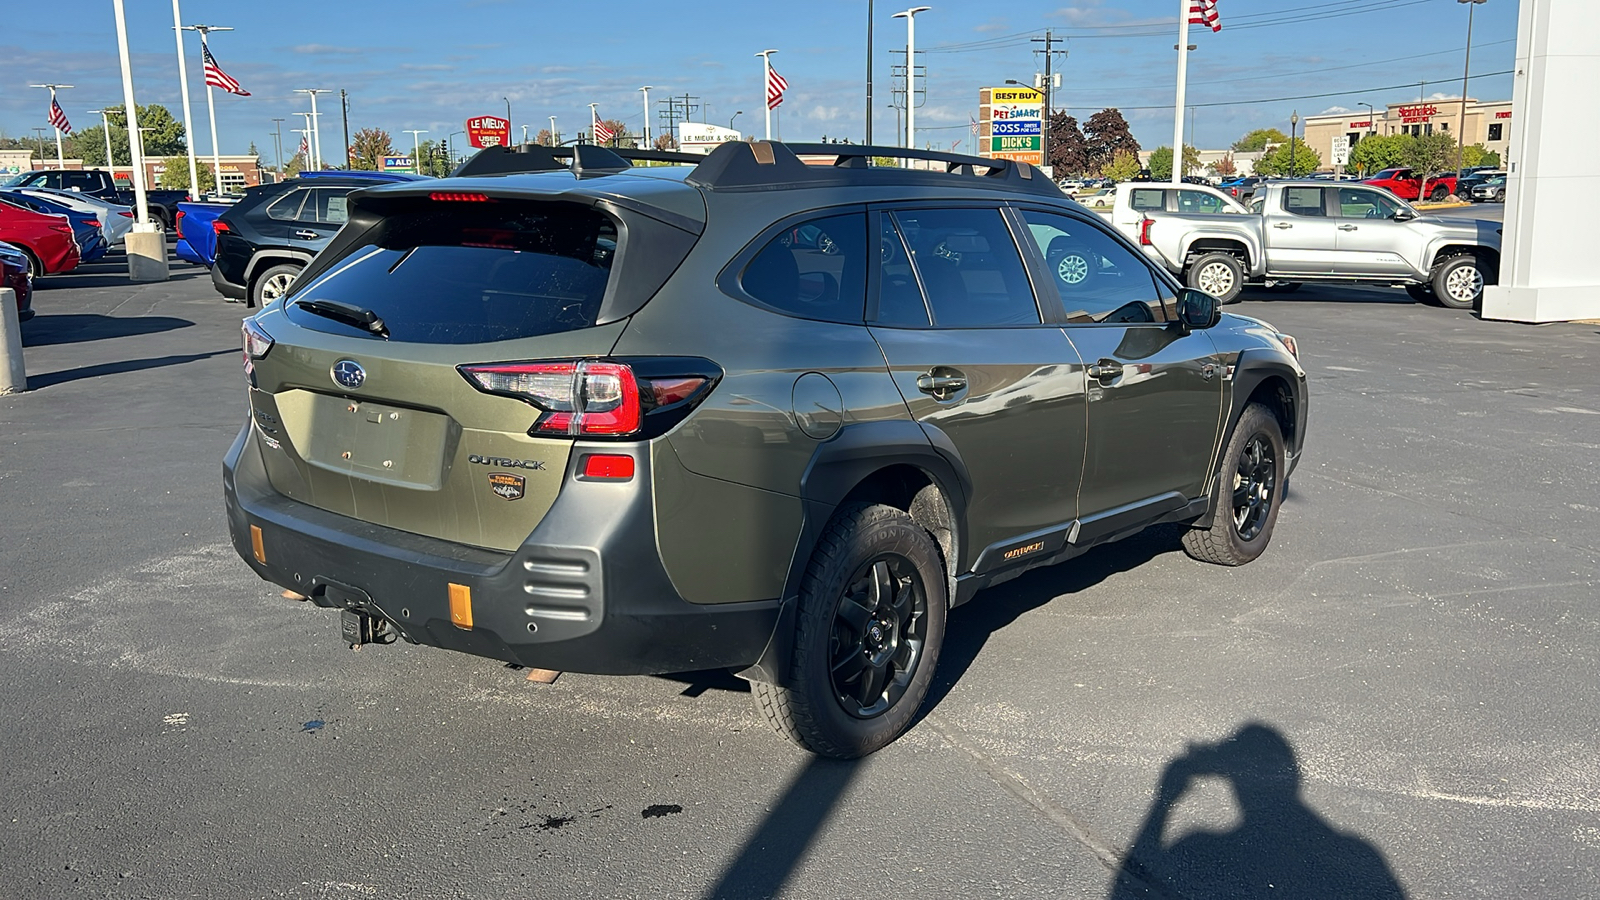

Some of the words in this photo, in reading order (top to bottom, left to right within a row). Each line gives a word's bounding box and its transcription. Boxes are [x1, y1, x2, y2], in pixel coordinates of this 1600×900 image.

[995, 92, 1017, 100] BEST
[471, 119, 480, 129] LE
[482, 118, 505, 129] MIEUX
[993, 124, 1019, 133] ROSS
[1001, 136, 1032, 148] DICK'S
[1016, 154, 1039, 162] BEAUTY
[468, 454, 546, 471] OUTBACK
[1003, 541, 1042, 559] OUTBACK
